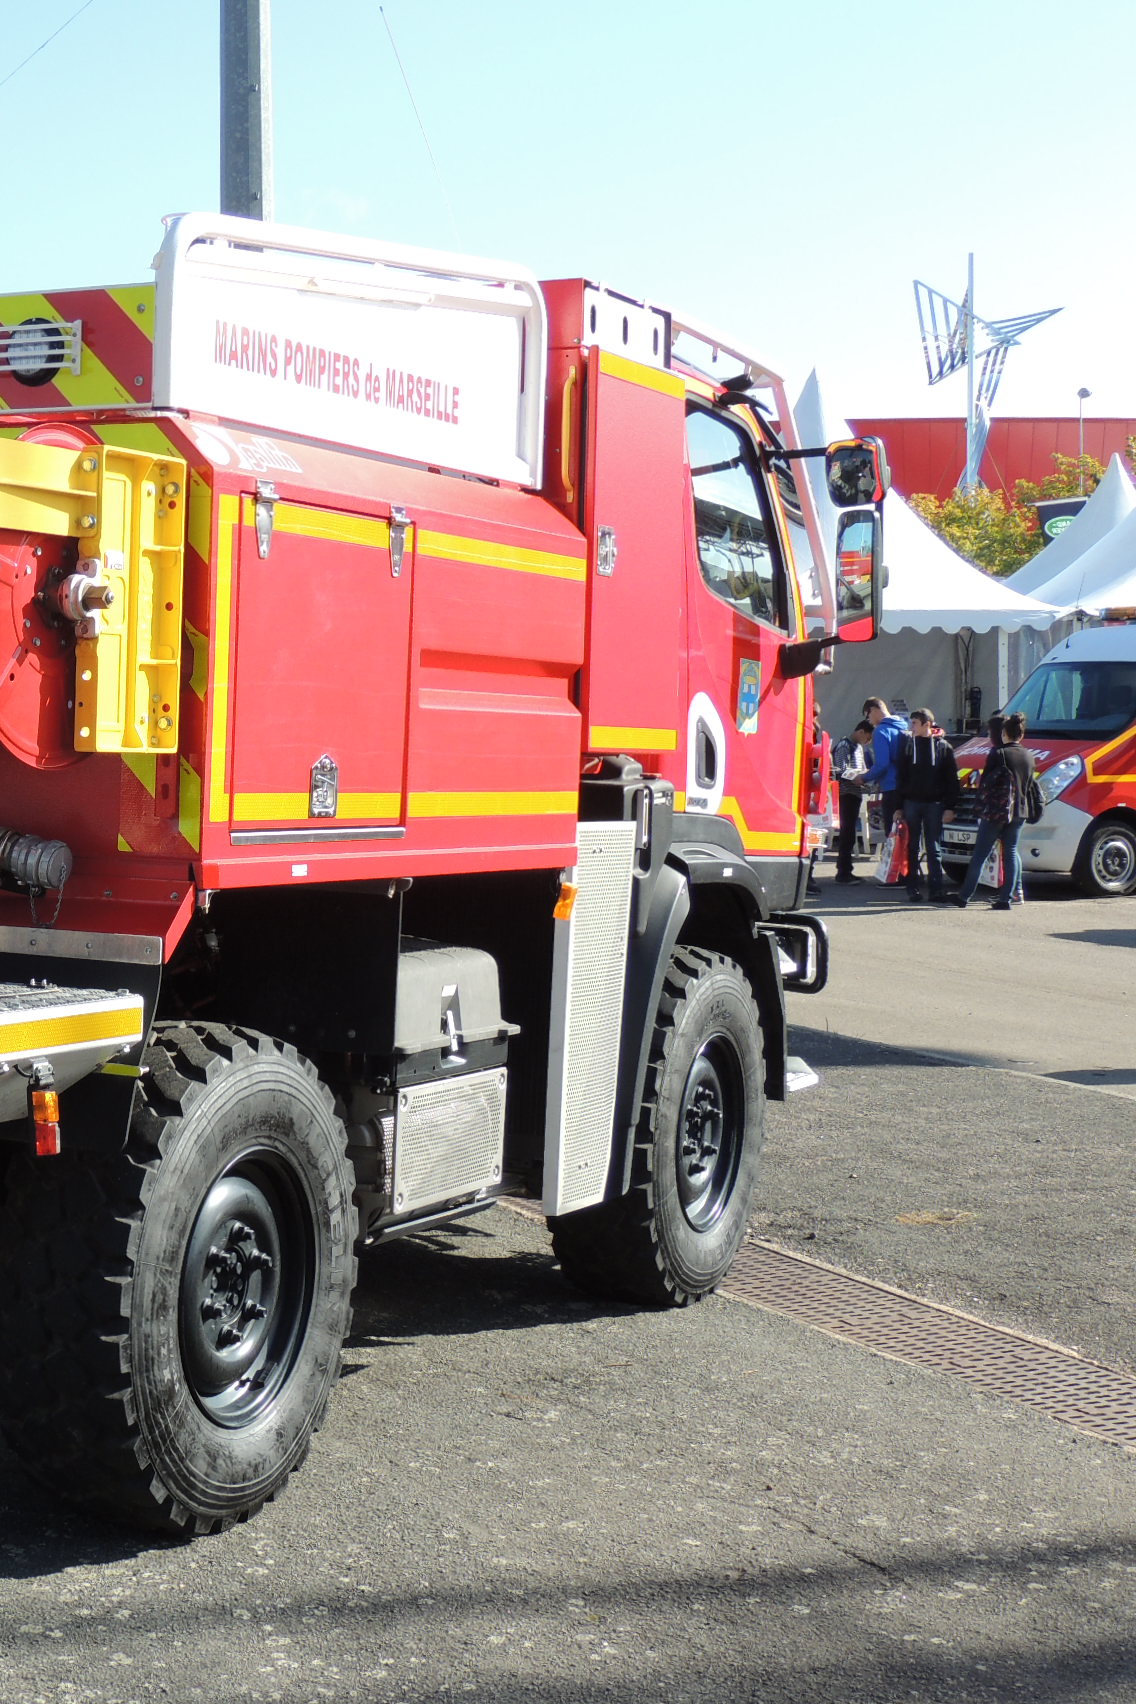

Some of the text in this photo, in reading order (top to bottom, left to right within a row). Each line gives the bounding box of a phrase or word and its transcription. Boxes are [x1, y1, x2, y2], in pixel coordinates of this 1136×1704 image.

[214, 319, 460, 425] MARINS POMPIERS de MARSEILLE
